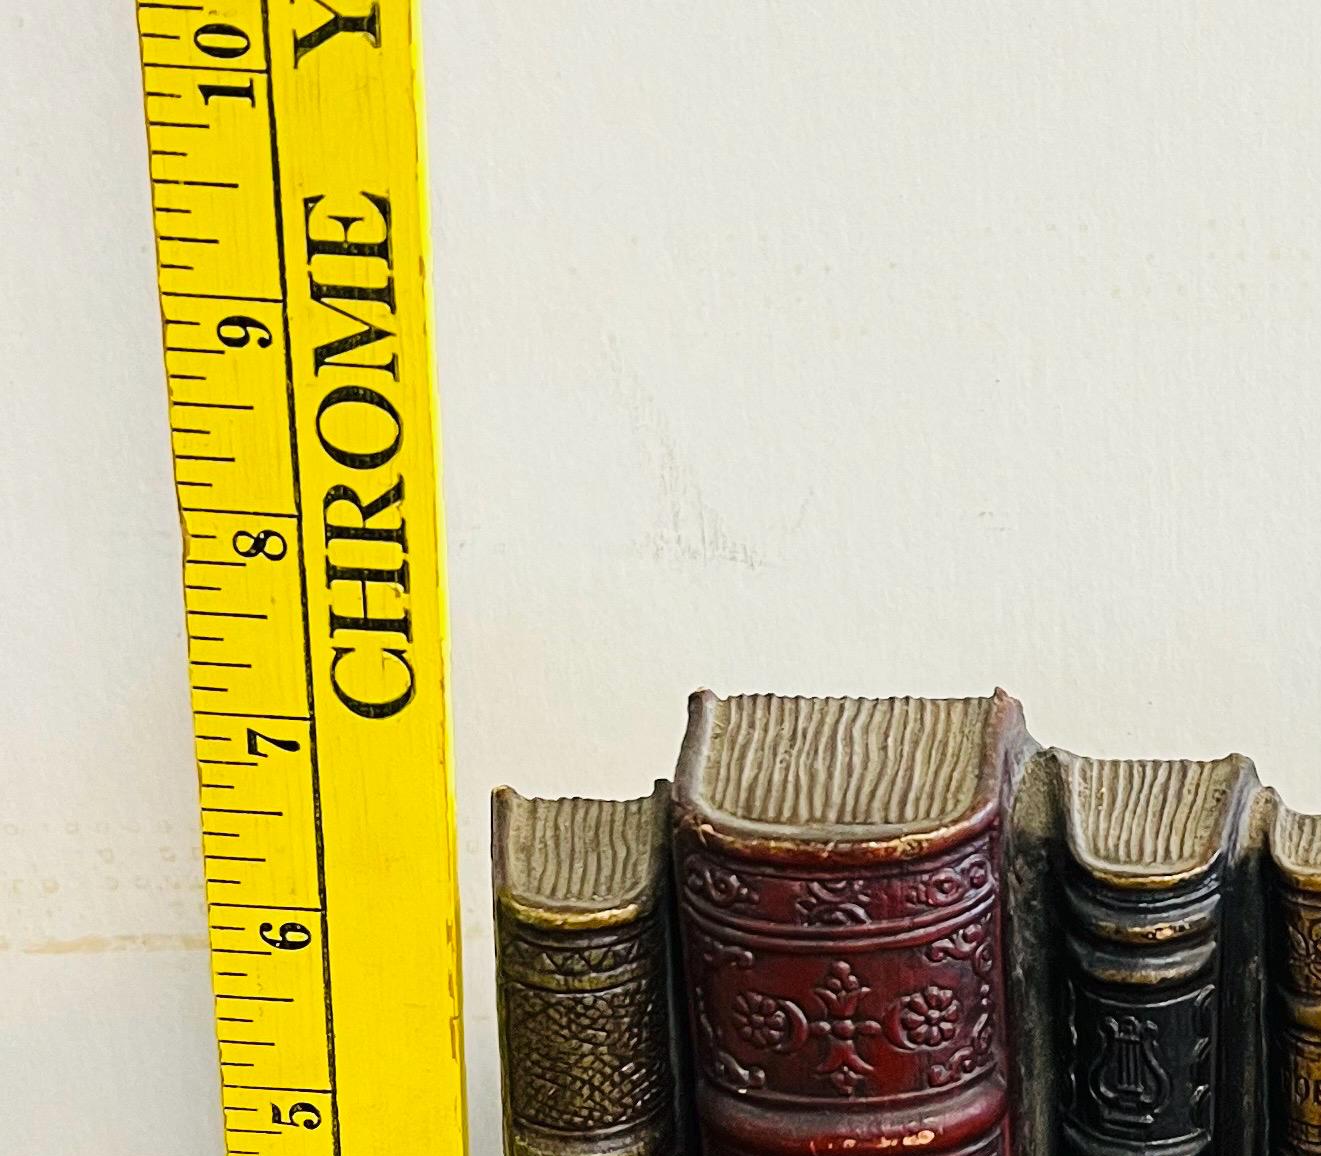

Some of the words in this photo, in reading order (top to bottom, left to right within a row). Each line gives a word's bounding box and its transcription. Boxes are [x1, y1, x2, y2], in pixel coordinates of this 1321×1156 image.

[193, 22, 256, 108] 10
[216, 315, 273, 349] 9
[303, 189, 416, 720] CHROME
[232, 529, 288, 562] 8
[246, 727, 301, 758] 7
[258, 921, 312, 951] 6
[271, 1101, 323, 1131] 5
